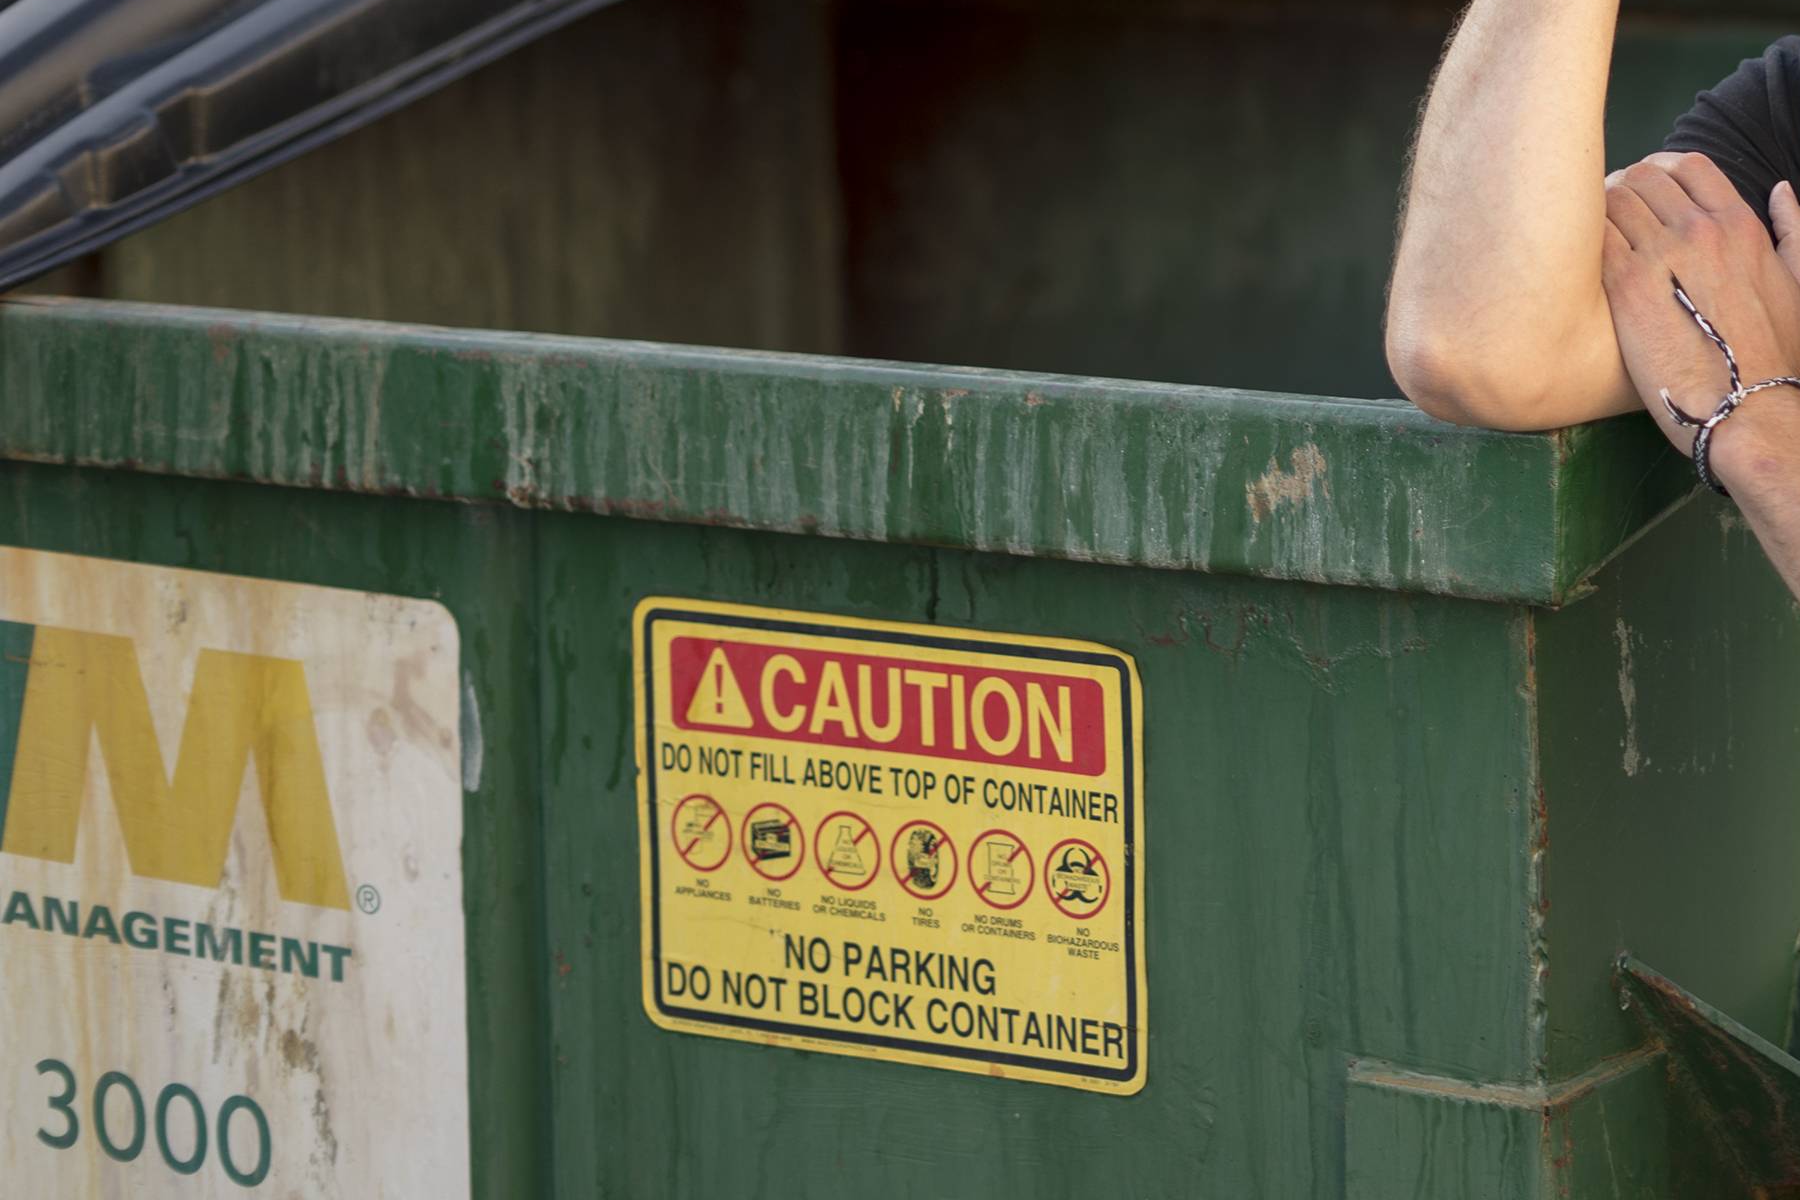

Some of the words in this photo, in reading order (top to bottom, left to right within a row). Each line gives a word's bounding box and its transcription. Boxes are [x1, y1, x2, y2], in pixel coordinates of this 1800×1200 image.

[760, 653, 1073, 763] CAUTION
[0, 619, 352, 912] M
[661, 742, 692, 773] DO
[699, 746, 743, 778] NOT
[750, 752, 796, 785] FILL
[802, 758, 883, 794] ABOVE
[888, 767, 936, 800] TOP
[944, 773, 975, 805] OF
[983, 778, 1119, 824] CONTAINER
[696, 878, 710, 889] NO
[675, 885, 732, 902] APPLIANCES
[767, 888, 782, 898] NO
[748, 895, 801, 911] BATTERIES
[820, 895, 836, 905] NO
[838, 897, 877, 911] LIQUIDS
[812, 903, 827, 914] OR
[829, 906, 887, 922] CHEMICALS
[917, 907, 933, 918] NO
[912, 915, 941, 929] TIRES
[974, 914, 988, 925] NO
[990, 916, 1023, 929] DRUMS
[961, 923, 976, 933] OR
[977, 925, 1036, 941] CONTAINERS
[1076, 927, 1090, 938] NO
[1047, 934, 1120, 952] BIOHAZARDOUS
[1067, 946, 1100, 960] WASTE
[785, 933, 831, 973] NO
[843, 941, 996, 996] PARKING
[667, 961, 711, 1001] DO
[722, 969, 788, 1012] NOT
[799, 980, 916, 1030] BLOCK
[926, 998, 1124, 1060] CONTAINER
[35, 1058, 272, 1188] 3000
